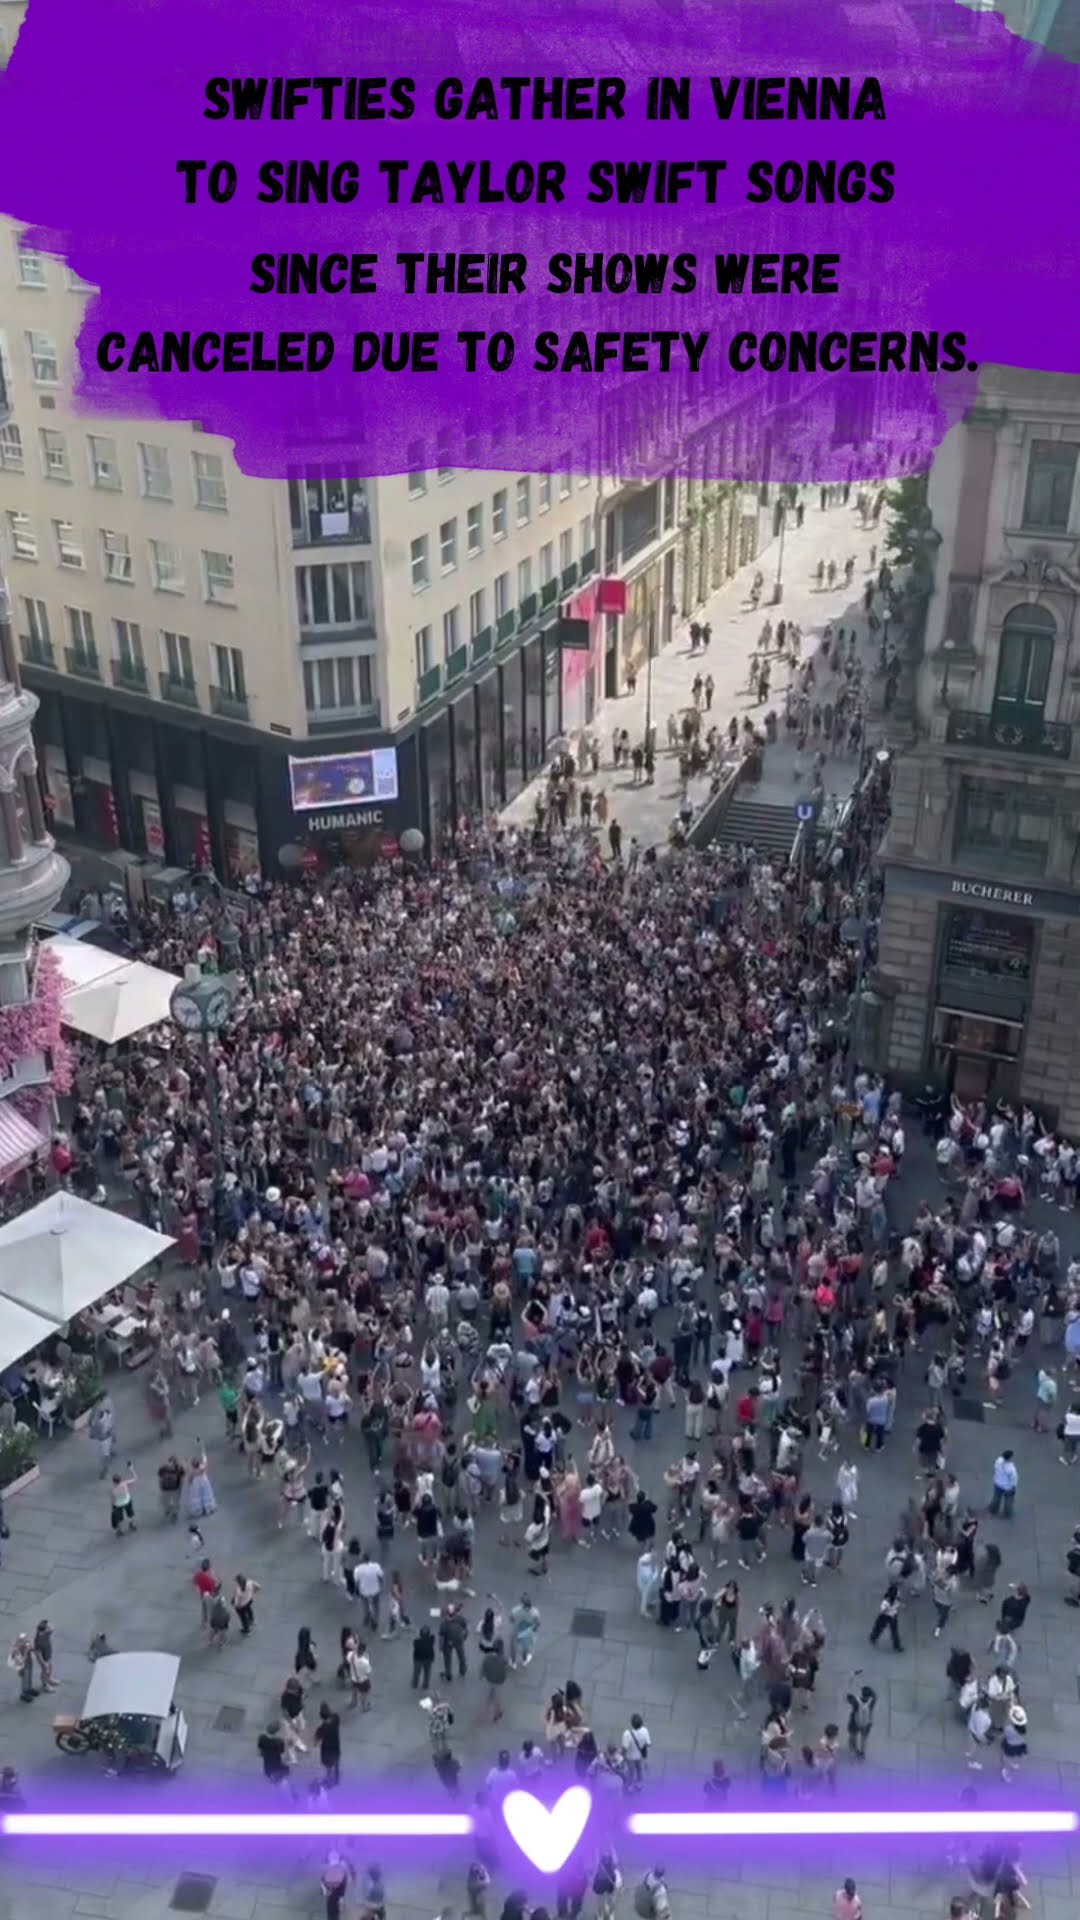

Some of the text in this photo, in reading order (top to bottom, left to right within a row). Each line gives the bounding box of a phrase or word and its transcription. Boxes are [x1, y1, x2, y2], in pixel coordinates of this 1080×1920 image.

[308, 810, 384, 831] HUMANIC
[798, 805, 812, 820] U
[952, 880, 1033, 905] BUCHERER
